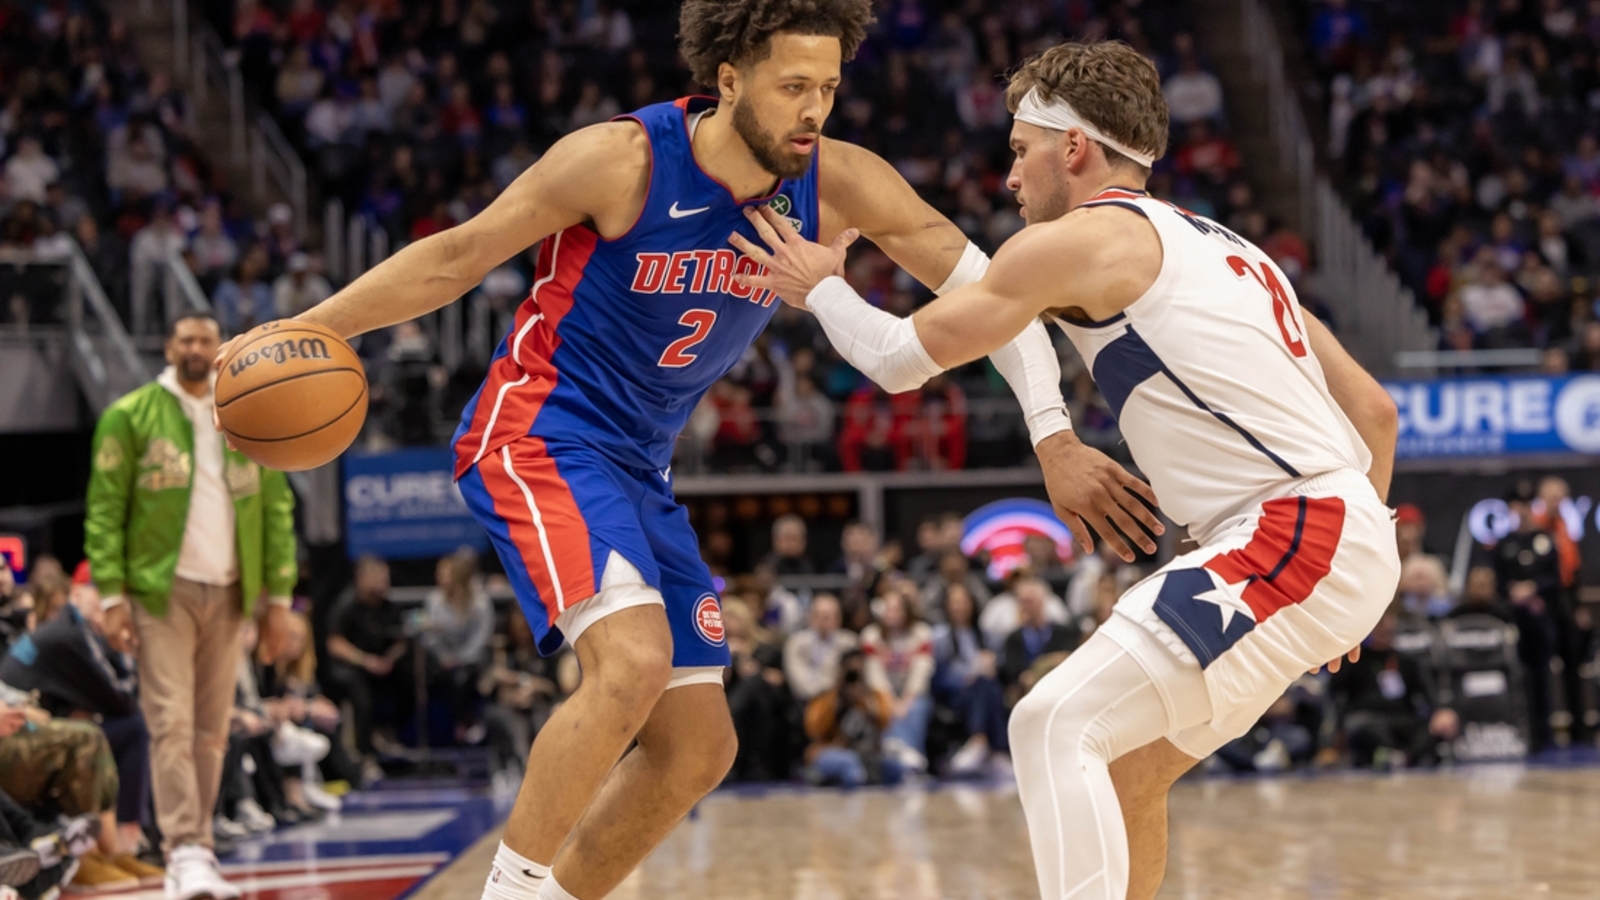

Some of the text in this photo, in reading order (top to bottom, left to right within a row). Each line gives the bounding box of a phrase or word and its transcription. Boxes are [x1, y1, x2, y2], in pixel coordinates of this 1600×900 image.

[657, 309, 717, 368] 2
[229, 337, 331, 378] Wilson
[702, 610, 720, 620] DETRO
[703, 618, 723, 628] PISTON
